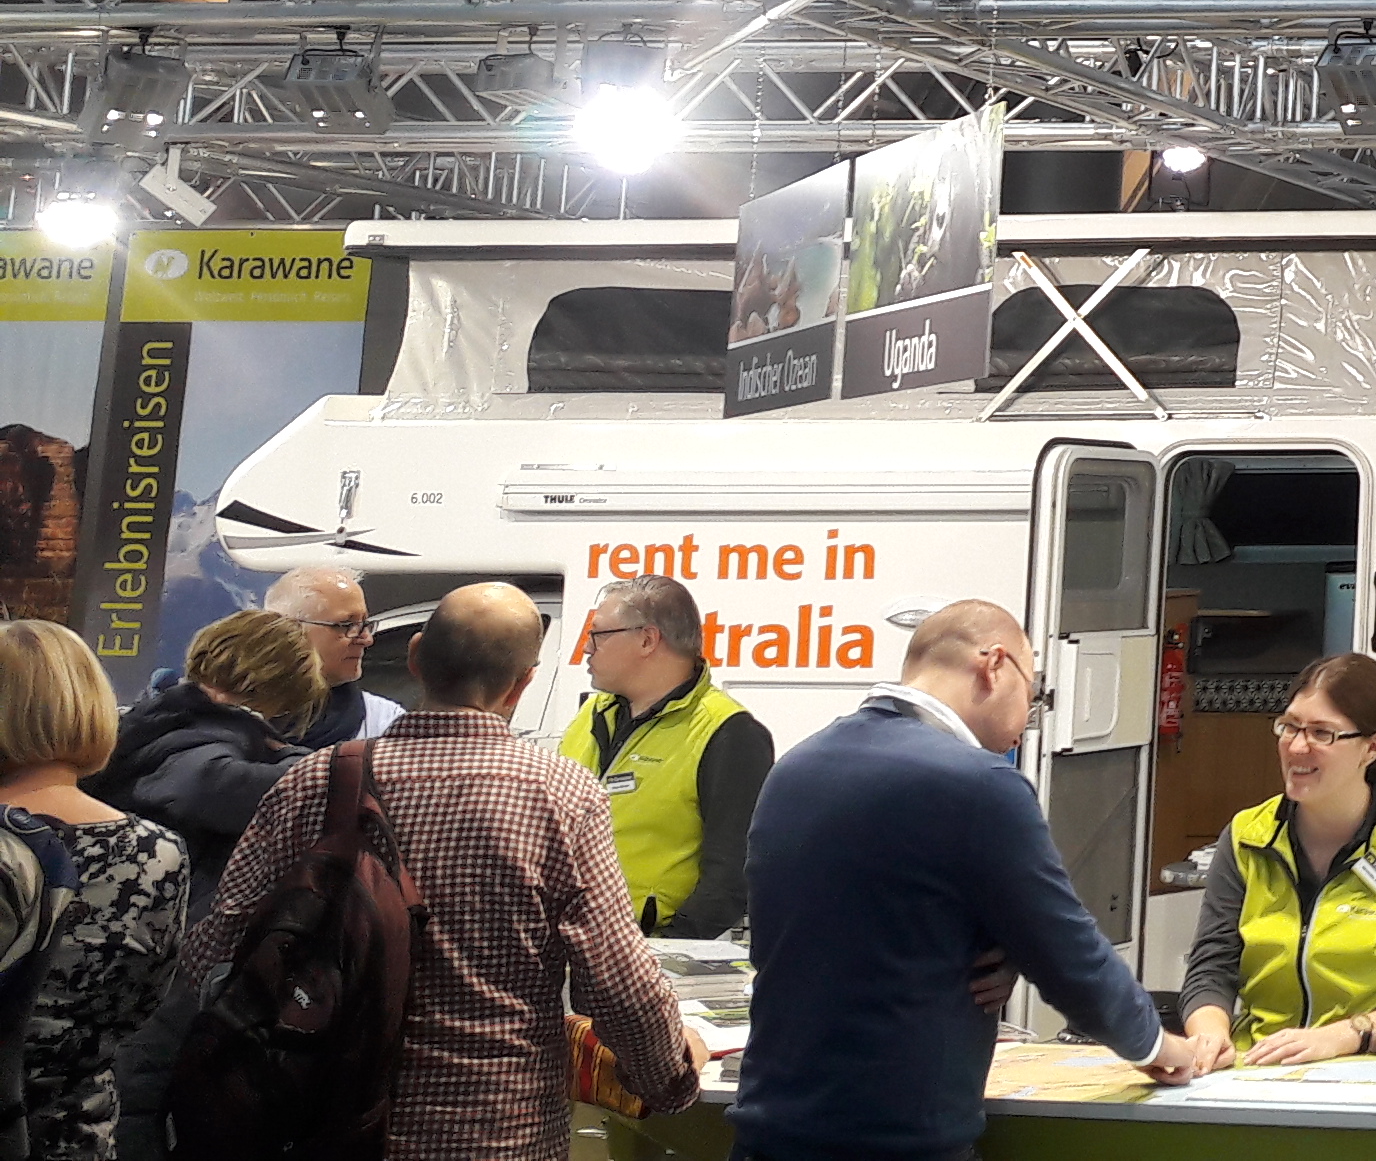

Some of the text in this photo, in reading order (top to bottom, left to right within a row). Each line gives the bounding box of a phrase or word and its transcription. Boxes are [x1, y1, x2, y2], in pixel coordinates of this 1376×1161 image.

[198, 248, 355, 280] Karawane
[738, 349, 817, 402] Indischer Ozean
[883, 318, 937, 389] Uganda
[97, 340, 174, 659] Erlebnisreisen
[410, 493, 444, 505] 6.002
[543, 495, 576, 504] THULE
[587, 528, 876, 581] rent me in
[569, 604, 875, 669] Atralia
